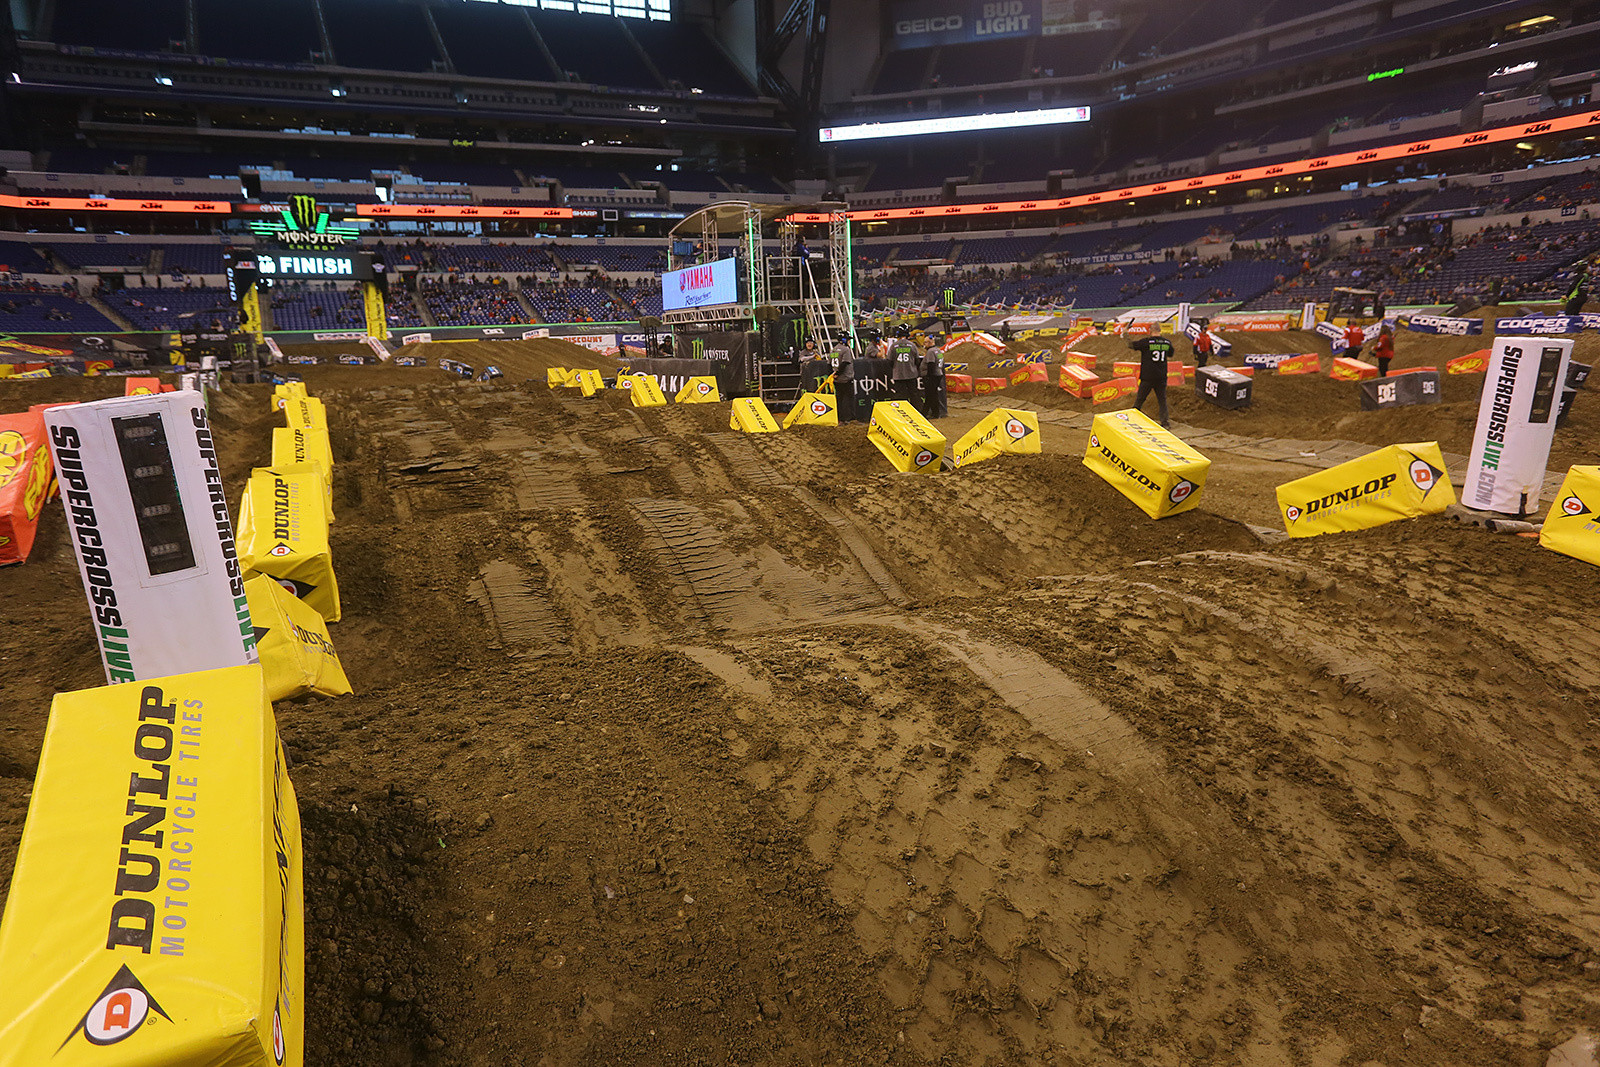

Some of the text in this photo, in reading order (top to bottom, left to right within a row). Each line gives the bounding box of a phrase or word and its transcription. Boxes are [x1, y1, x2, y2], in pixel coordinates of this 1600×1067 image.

[983, 1, 1023, 18] BUD
[896, 16, 963, 35] GEICO
[976, 14, 1031, 35] LIGHT
[1523, 123, 1552, 135] KTM
[1463, 133, 1488, 144] KTM
[1356, 151, 1377, 161] KTM
[1407, 143, 1430, 153] KTM
[1562, 207, 1575, 215] 139
[277, 231, 345, 245] MONSTER
[279, 256, 353, 275] FINISH
[1092, 254, 1108, 263] TEXT
[686, 265, 714, 291] YAMAHA
[1410, 316, 1470, 330] COOPER
[1436, 326, 1467, 335] TIRES
[1497, 318, 1570, 329] COOPER
[1530, 326, 1567, 334] TIRES
[1066, 331, 1088, 350] HONDA
[339, 354, 364, 362] GoPro
[702, 349, 730, 361] MONSTER
[896, 353, 910, 363] 46
[1151, 350, 1166, 362] 31
[1378, 382, 1397, 404] DC
[897, 408, 932, 440] DUNLOP
[294, 428, 305, 464] UNLOP
[876, 424, 909, 458] DUNLOP
[962, 425, 999, 460] DUNLOP
[1100, 445, 1161, 492] DUNLOP
[1133, 479, 1153, 497] TIRES
[1306, 473, 1397, 515] DUNLOP
[274, 478, 289, 541] DUNLOP
[1306, 489, 1393, 523] MOTORCYCLE TIRES
[106, 685, 177, 955] DUNLOP
[159, 698, 204, 957] MOTORCYCLE TIRES
